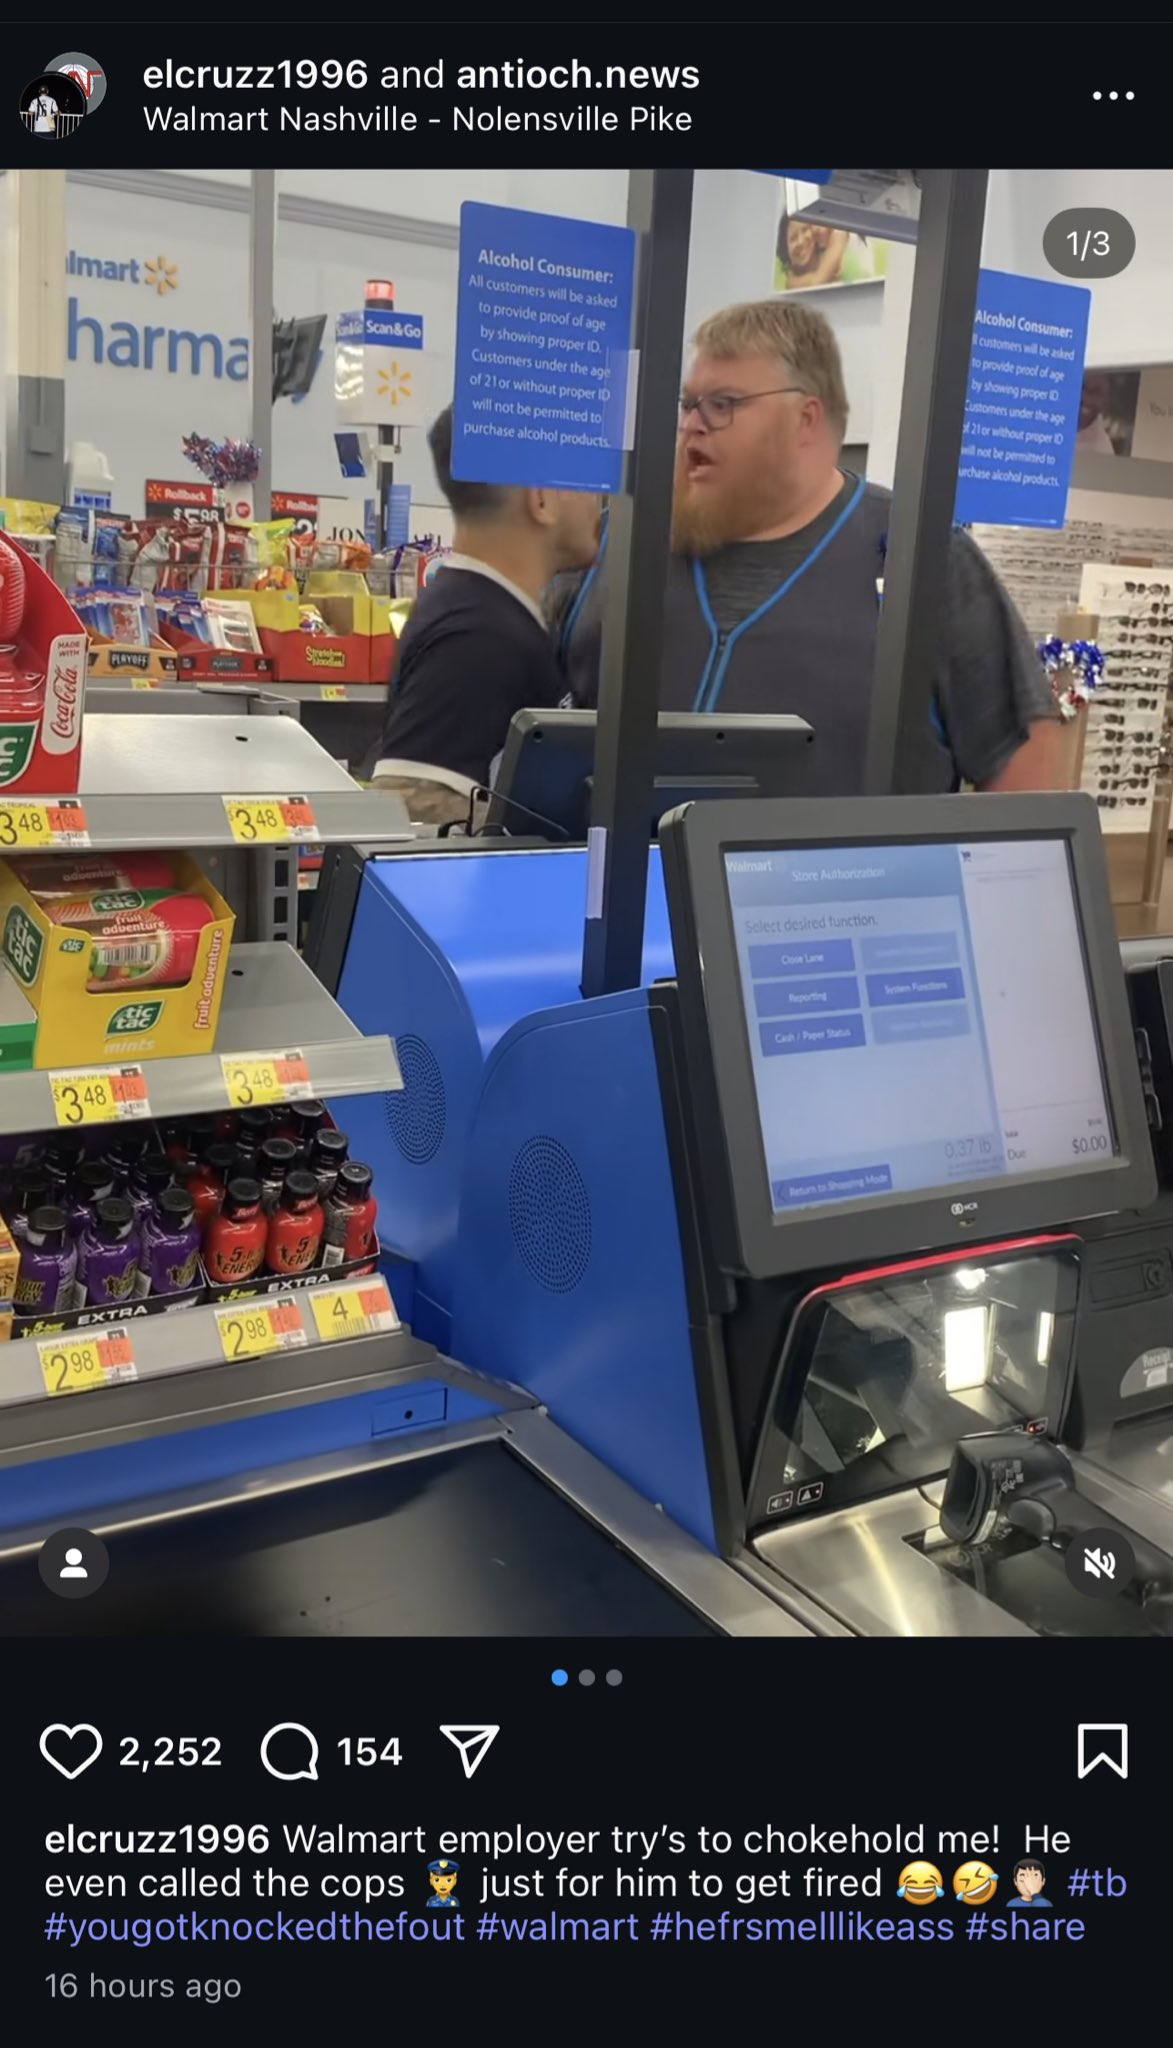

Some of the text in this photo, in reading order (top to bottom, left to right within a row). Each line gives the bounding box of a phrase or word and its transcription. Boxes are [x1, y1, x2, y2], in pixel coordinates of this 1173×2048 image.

[66, 250, 140, 284] lmart
[478, 249, 614, 284] Alcohol Consumer:
[468, 274, 618, 309] All customers will be asked
[479, 302, 606, 333] to provide proof of age
[974, 310, 1073, 339] Alcohol Consumer:
[68, 296, 249, 382] harma
[480, 324, 602, 354] by showing proper ID.
[979, 337, 1075, 361] customers will be asked
[471, 348, 611, 381] Customers under the age
[972, 357, 1064, 383] to provide proof of age
[469, 374, 482, 386] of
[513, 379, 557, 396] without
[559, 384, 596, 401] proper
[597, 388, 611, 401] ID
[971, 378, 1049, 401] by showing proper
[472, 399, 602, 424] will not be permitted to
[1009, 406, 1033, 421] under
[1034, 408, 1048, 422] the
[1050, 412, 1065, 426] age
[463, 421, 611, 449] purchase alcohol products.
[992, 426, 1023, 442] without
[1025, 430, 1053, 445] proper
[1053, 433, 1064, 445] ID
[977, 447, 991, 459] not
[992, 448, 1003, 460] be
[1005, 449, 1046, 465] permitted
[1046, 453, 1056, 466] to
[958, 466, 990, 480] urchase
[991, 470, 1022, 484] alcohol
[164, 487, 207, 502] Rollback
[58, 640, 80, 649] MADE
[111, 653, 148, 667] PLAYOFF
[726, 860, 773, 873] Walmart
[792, 867, 885, 882] Store Authorization
[94, 900, 138, 910] tac
[102, 921, 165, 935] adventure
[115, 914, 142, 925] fruit
[745, 913, 878, 934] Select desired function.
[15, 914, 37, 958] tic
[8, 928, 33, 978] tac
[781, 952, 824, 965] Close Lane
[194, 929, 224, 1030] fruit adventure
[884, 981, 948, 995] System Functions
[788, 991, 828, 1004] Reporting
[126, 1005, 157, 1018] tic
[116, 1017, 151, 1030] tac
[775, 1028, 851, 1044] Cash Paper Status
[105, 1039, 156, 1054] mints
[944, 1137, 992, 1159] 0.37 lb
[1072, 1135, 1108, 1155] $0.00
[789, 1184, 817, 1197] Return
[865, 1174, 888, 1184] Mode
[268, 1273, 331, 1293] EXTRA
[77, 1305, 148, 1325] EXTRA
[333, 1296, 349, 1321] 4
